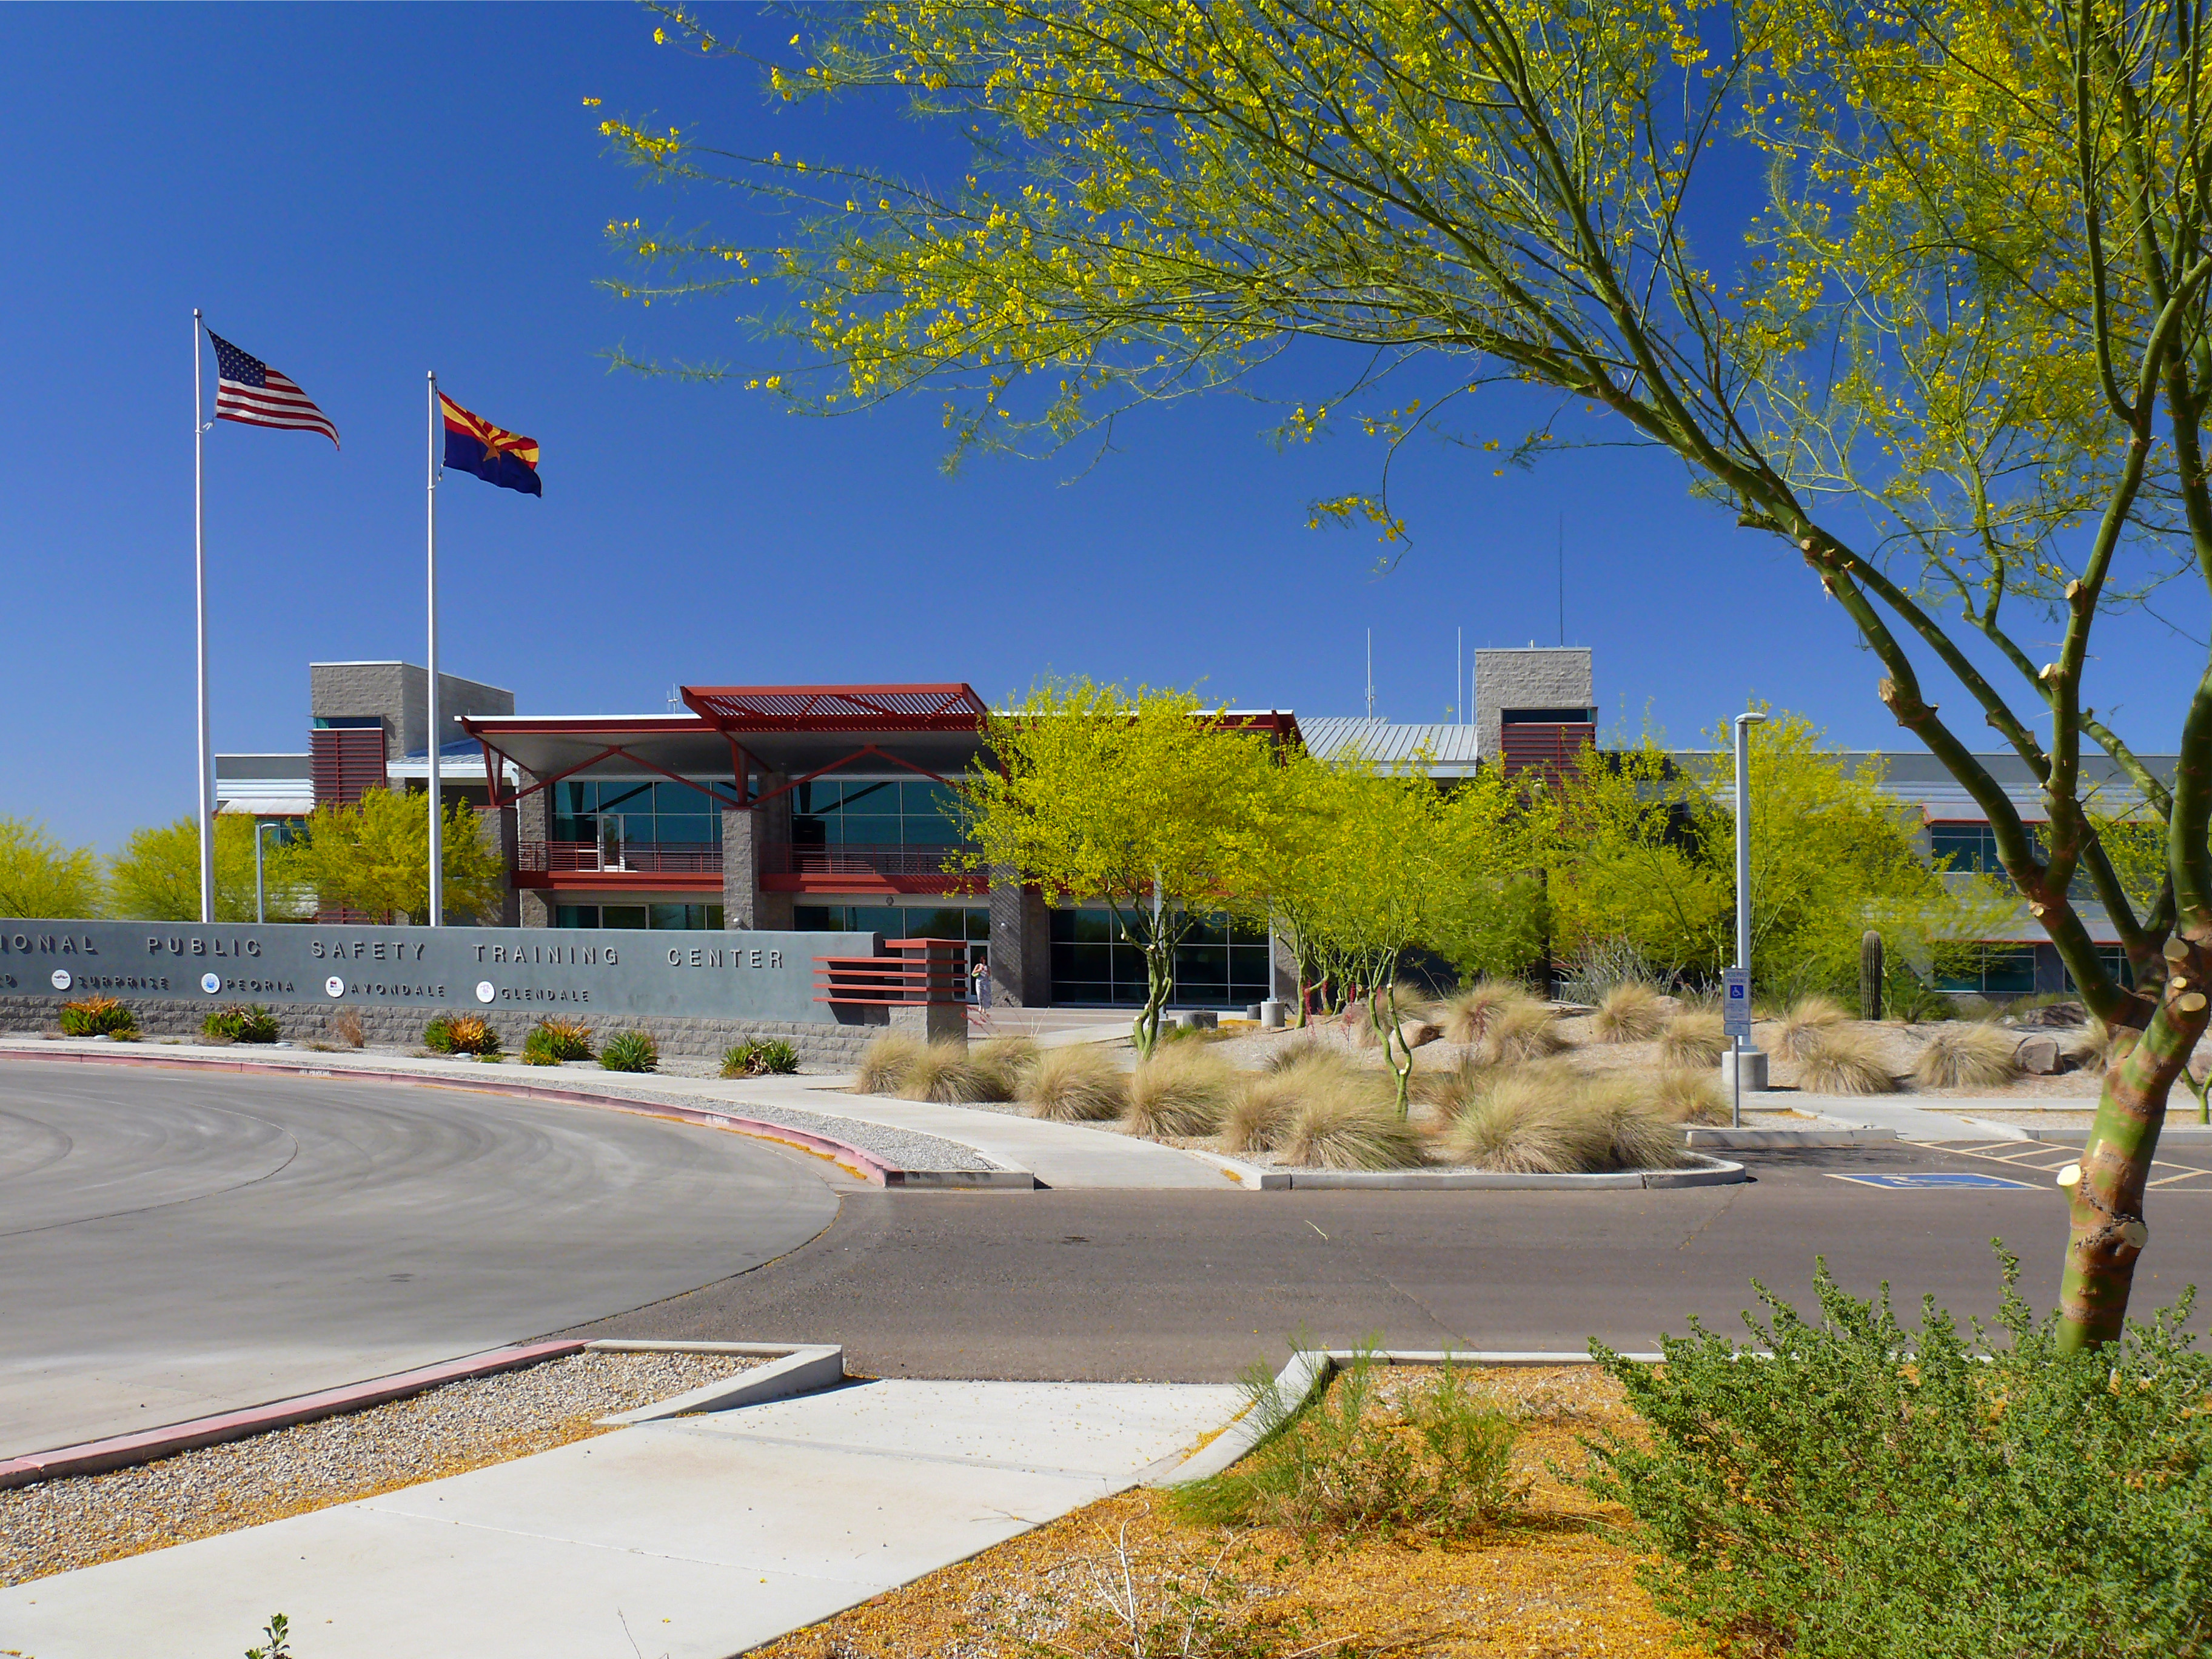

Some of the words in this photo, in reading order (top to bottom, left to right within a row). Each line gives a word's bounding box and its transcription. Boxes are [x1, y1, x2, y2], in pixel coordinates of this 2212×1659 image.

[0, 934, 94, 952] IONAL
[147, 937, 260, 956] PUBLIC
[311, 940, 424, 959] SAFETY
[472, 944, 617, 965] TRAINING
[668, 948, 782, 968] CENTER
[78, 974, 168, 988] SURPRISE
[226, 978, 295, 993] PEORIA
[350, 984, 445, 997] AVONDALE
[501, 988, 589, 1002] GLENDALE
